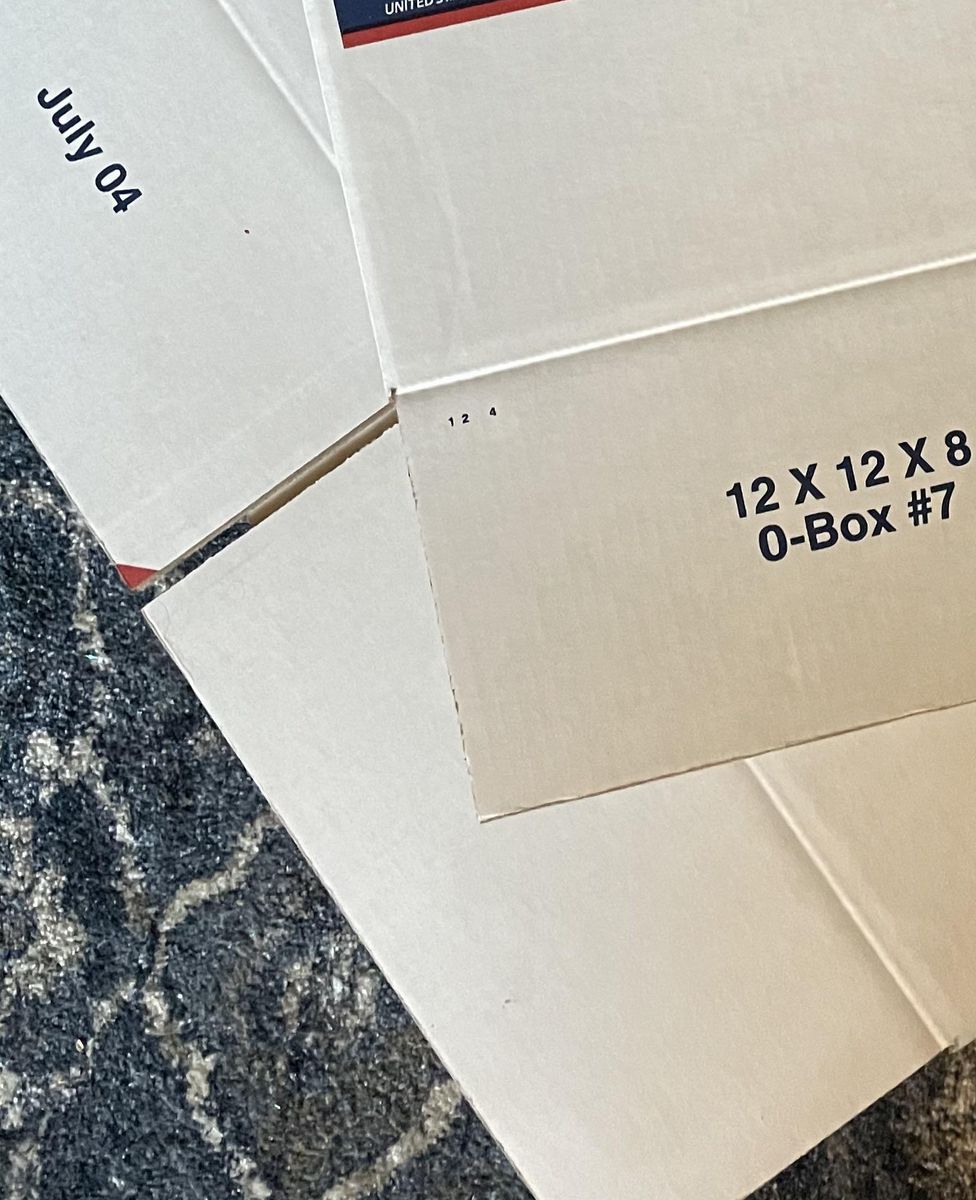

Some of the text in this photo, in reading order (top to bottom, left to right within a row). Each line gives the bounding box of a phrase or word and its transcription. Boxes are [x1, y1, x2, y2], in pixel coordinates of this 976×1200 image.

[37, 86, 143, 214] July 04
[726, 429, 971, 518] 12 X 12 X 8
[908, 481, 956, 526] #7
